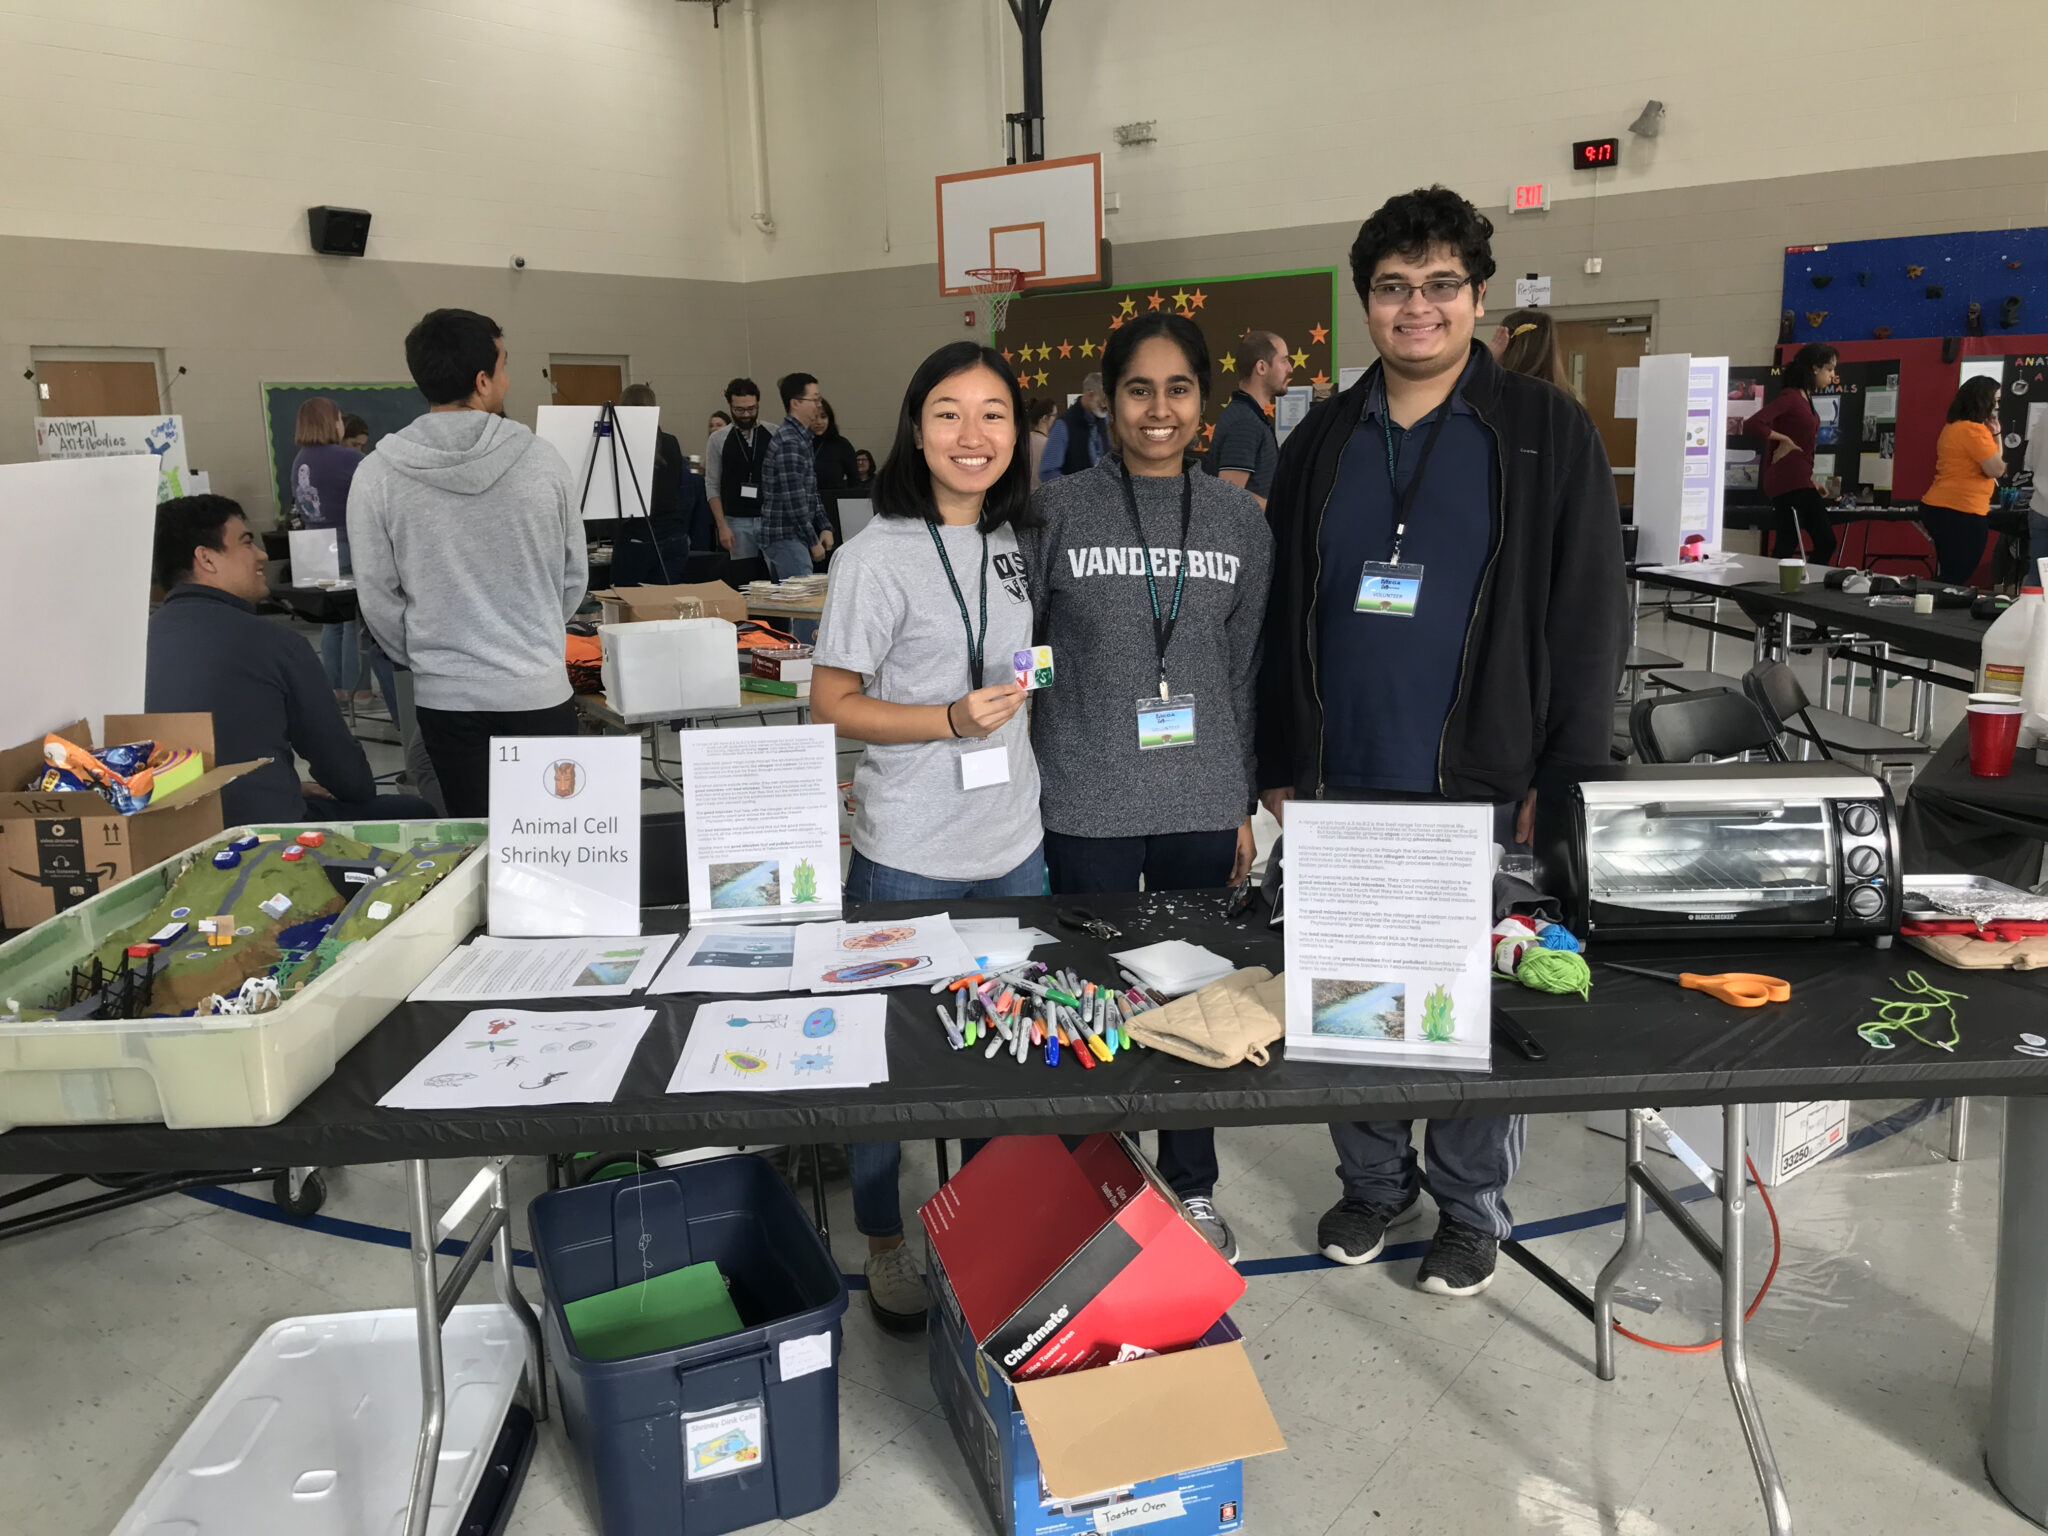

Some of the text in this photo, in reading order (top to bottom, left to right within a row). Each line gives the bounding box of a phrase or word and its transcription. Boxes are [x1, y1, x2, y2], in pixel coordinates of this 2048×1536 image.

[1585, 144, 1612, 161] 9:17
[1515, 184, 1543, 208] EXIT
[48, 420, 97, 437] Animal
[60, 433, 126, 451] Antibodies
[1067, 546, 1240, 584] VANDERBILT
[499, 746, 520, 762] 11
[512, 816, 618, 834] Animal Cell
[502, 846, 628, 867] Shrinky Dinks
[1784, 1146, 1809, 1170] 33250
[1004, 1306, 1069, 1366] Chefmate
[1040, 1343, 1062, 1362] Toaster
[1060, 1330, 1076, 1344] Oven
[691, 1412, 756, 1432] Shrinky Dink Cells
[1102, 1502, 1166, 1523] Toaster Oven
